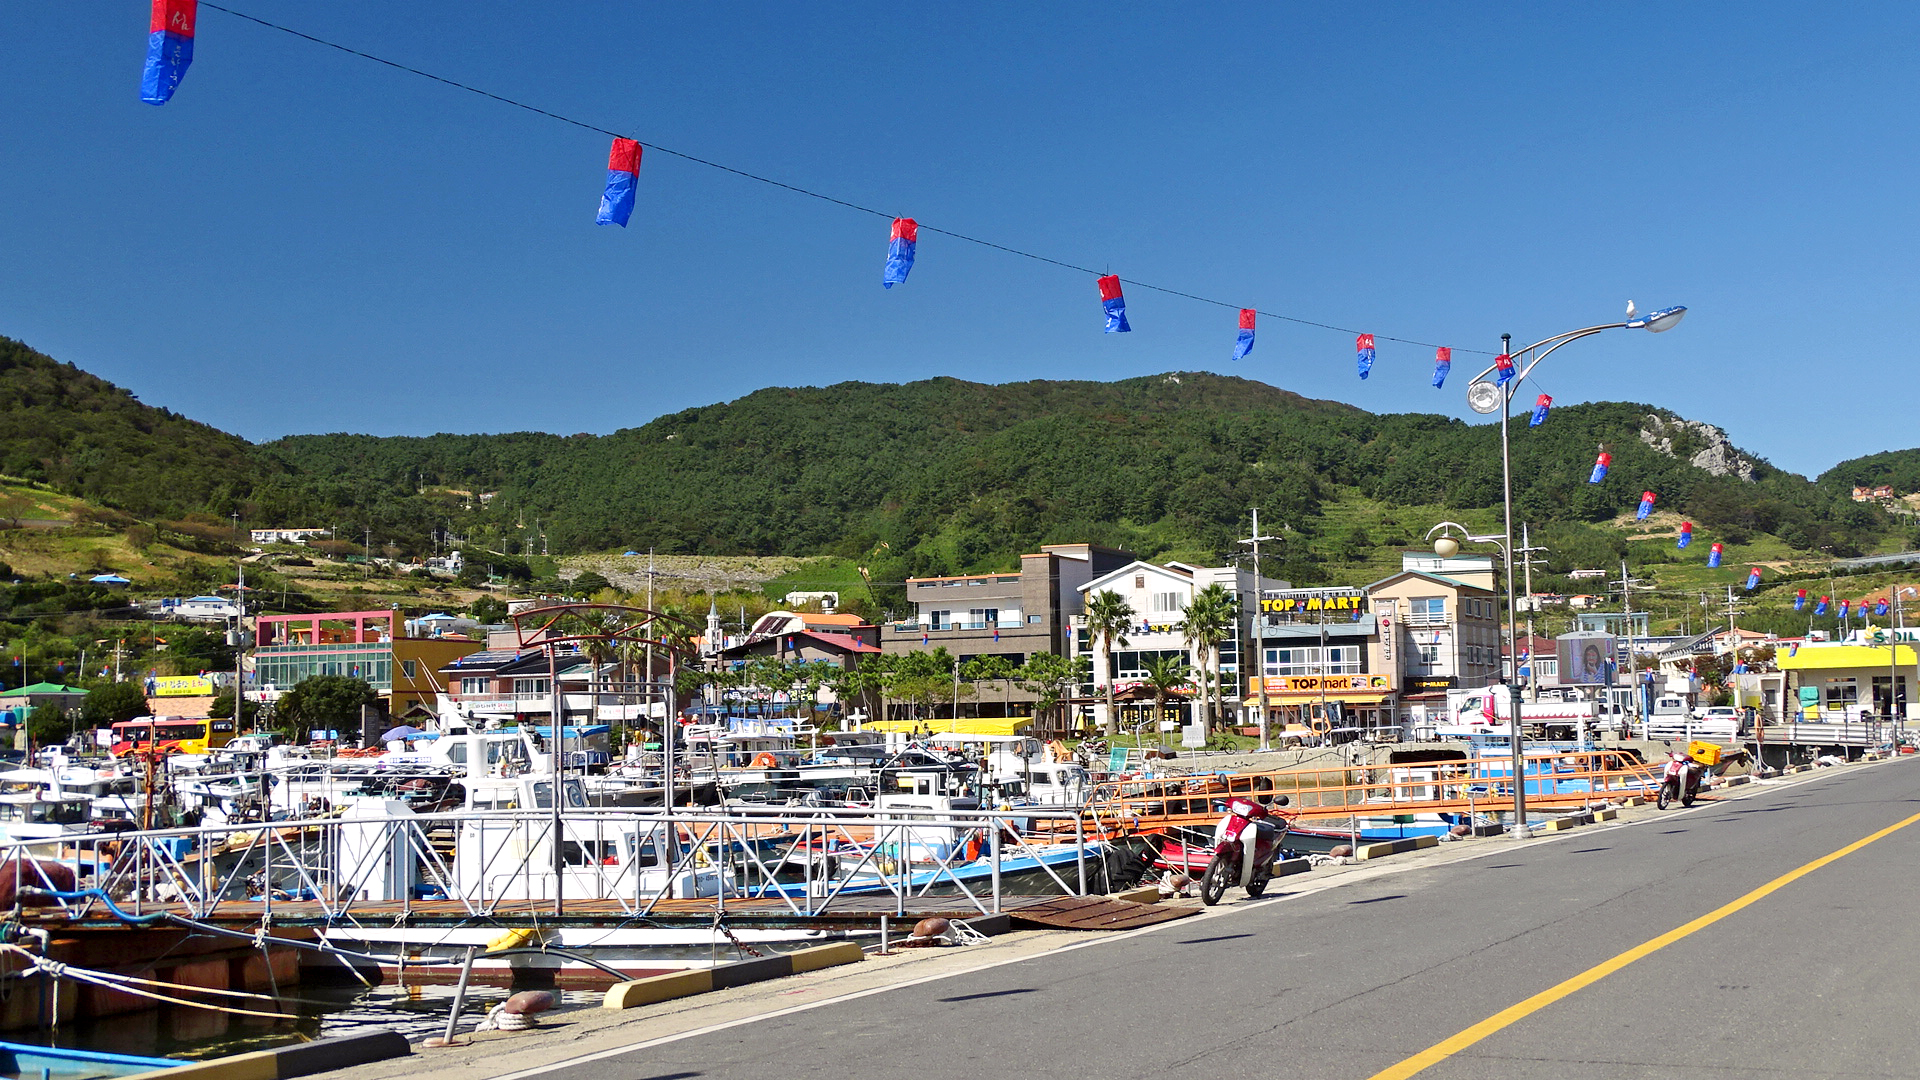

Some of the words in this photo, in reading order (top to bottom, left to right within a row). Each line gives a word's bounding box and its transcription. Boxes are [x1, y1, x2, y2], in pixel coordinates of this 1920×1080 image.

[1261, 598, 1295, 612] TOP
[1306, 596, 1361, 611] MART
[1873, 630, 1919, 643] S-OIL
[1291, 679, 1318, 689] TOP
[1320, 677, 1348, 688] mart
